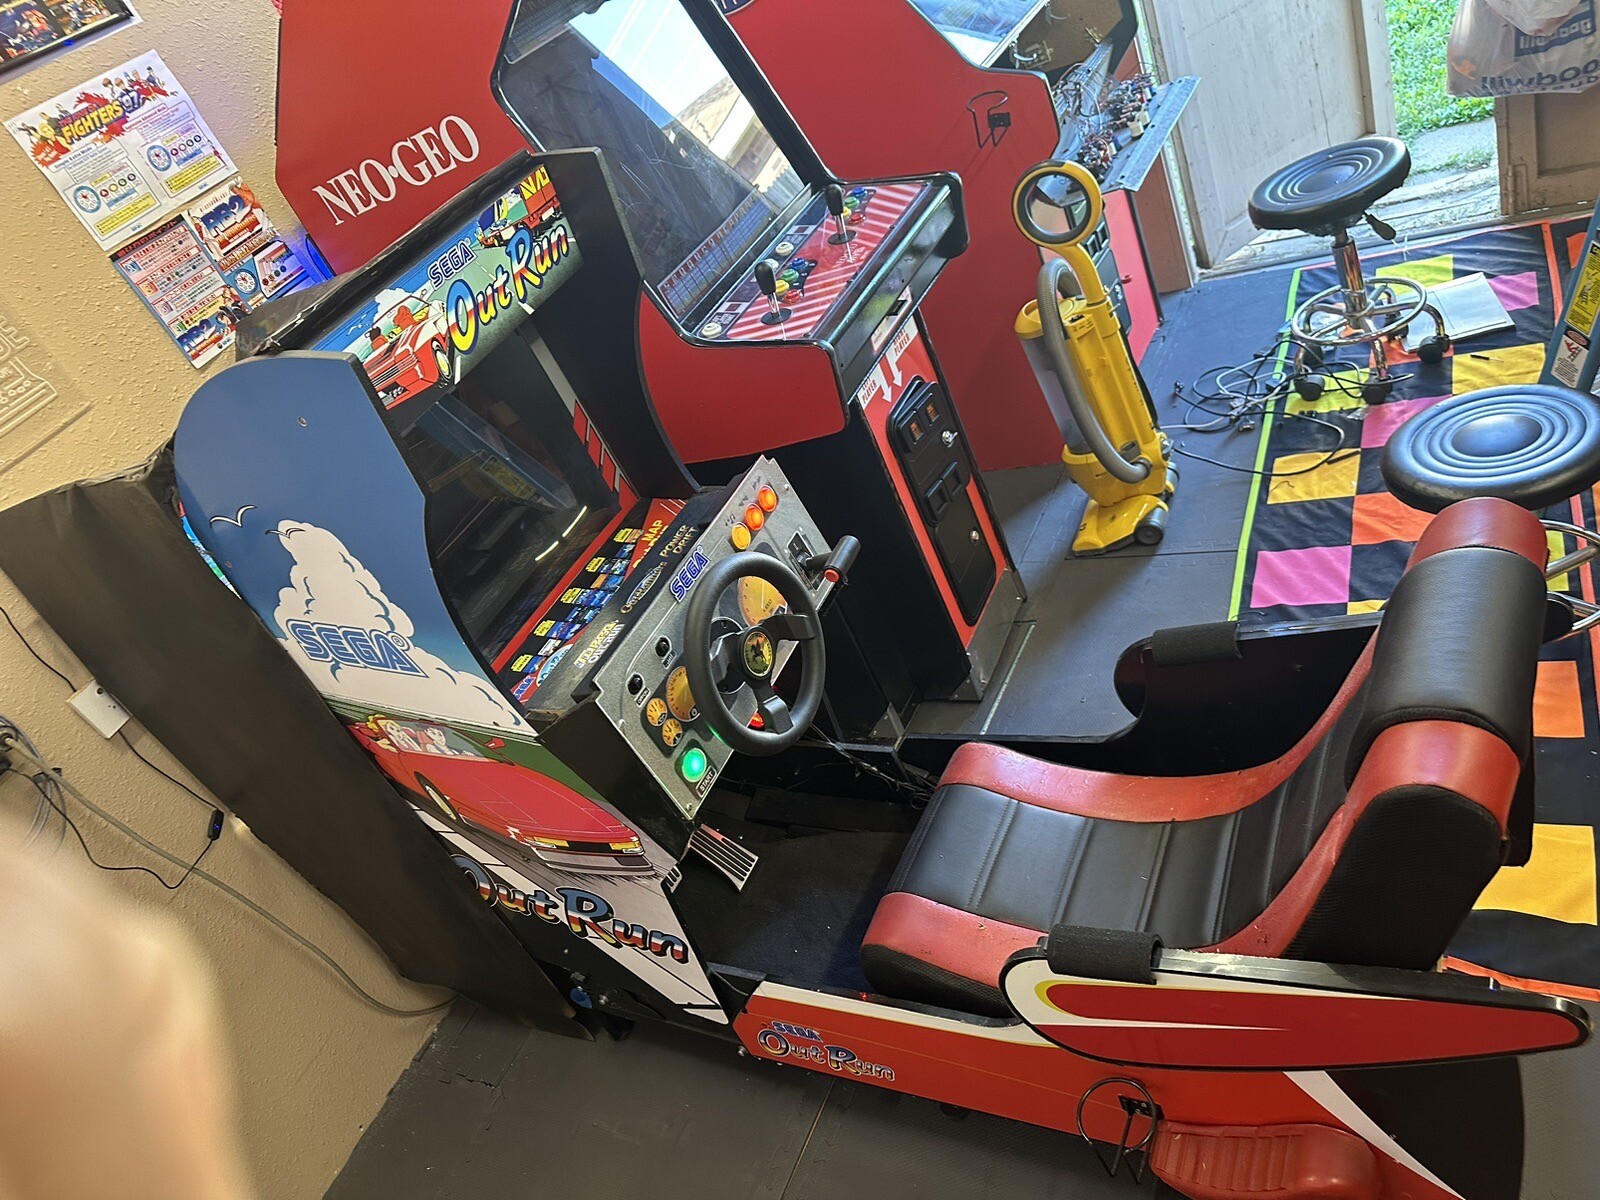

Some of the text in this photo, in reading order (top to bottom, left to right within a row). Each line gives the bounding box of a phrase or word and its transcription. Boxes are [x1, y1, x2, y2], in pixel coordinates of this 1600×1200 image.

[60, 98, 125, 143] FIGHTERS
[79, 145, 92, 154] Mode
[202, 194, 252, 239] RB2
[427, 242, 478, 289] SEGA
[893, 331, 911, 356] PLAYER
[860, 378, 878, 403] PLAYER
[641, 520, 664, 541] MAP
[660, 525, 689, 558] POWER
[672, 527, 698, 554] DRIFT
[670, 551, 711, 602] SEGA
[288, 621, 426, 677] SEGA
[699, 771, 715, 792] START
[772, 1022, 822, 1041] SEGA
